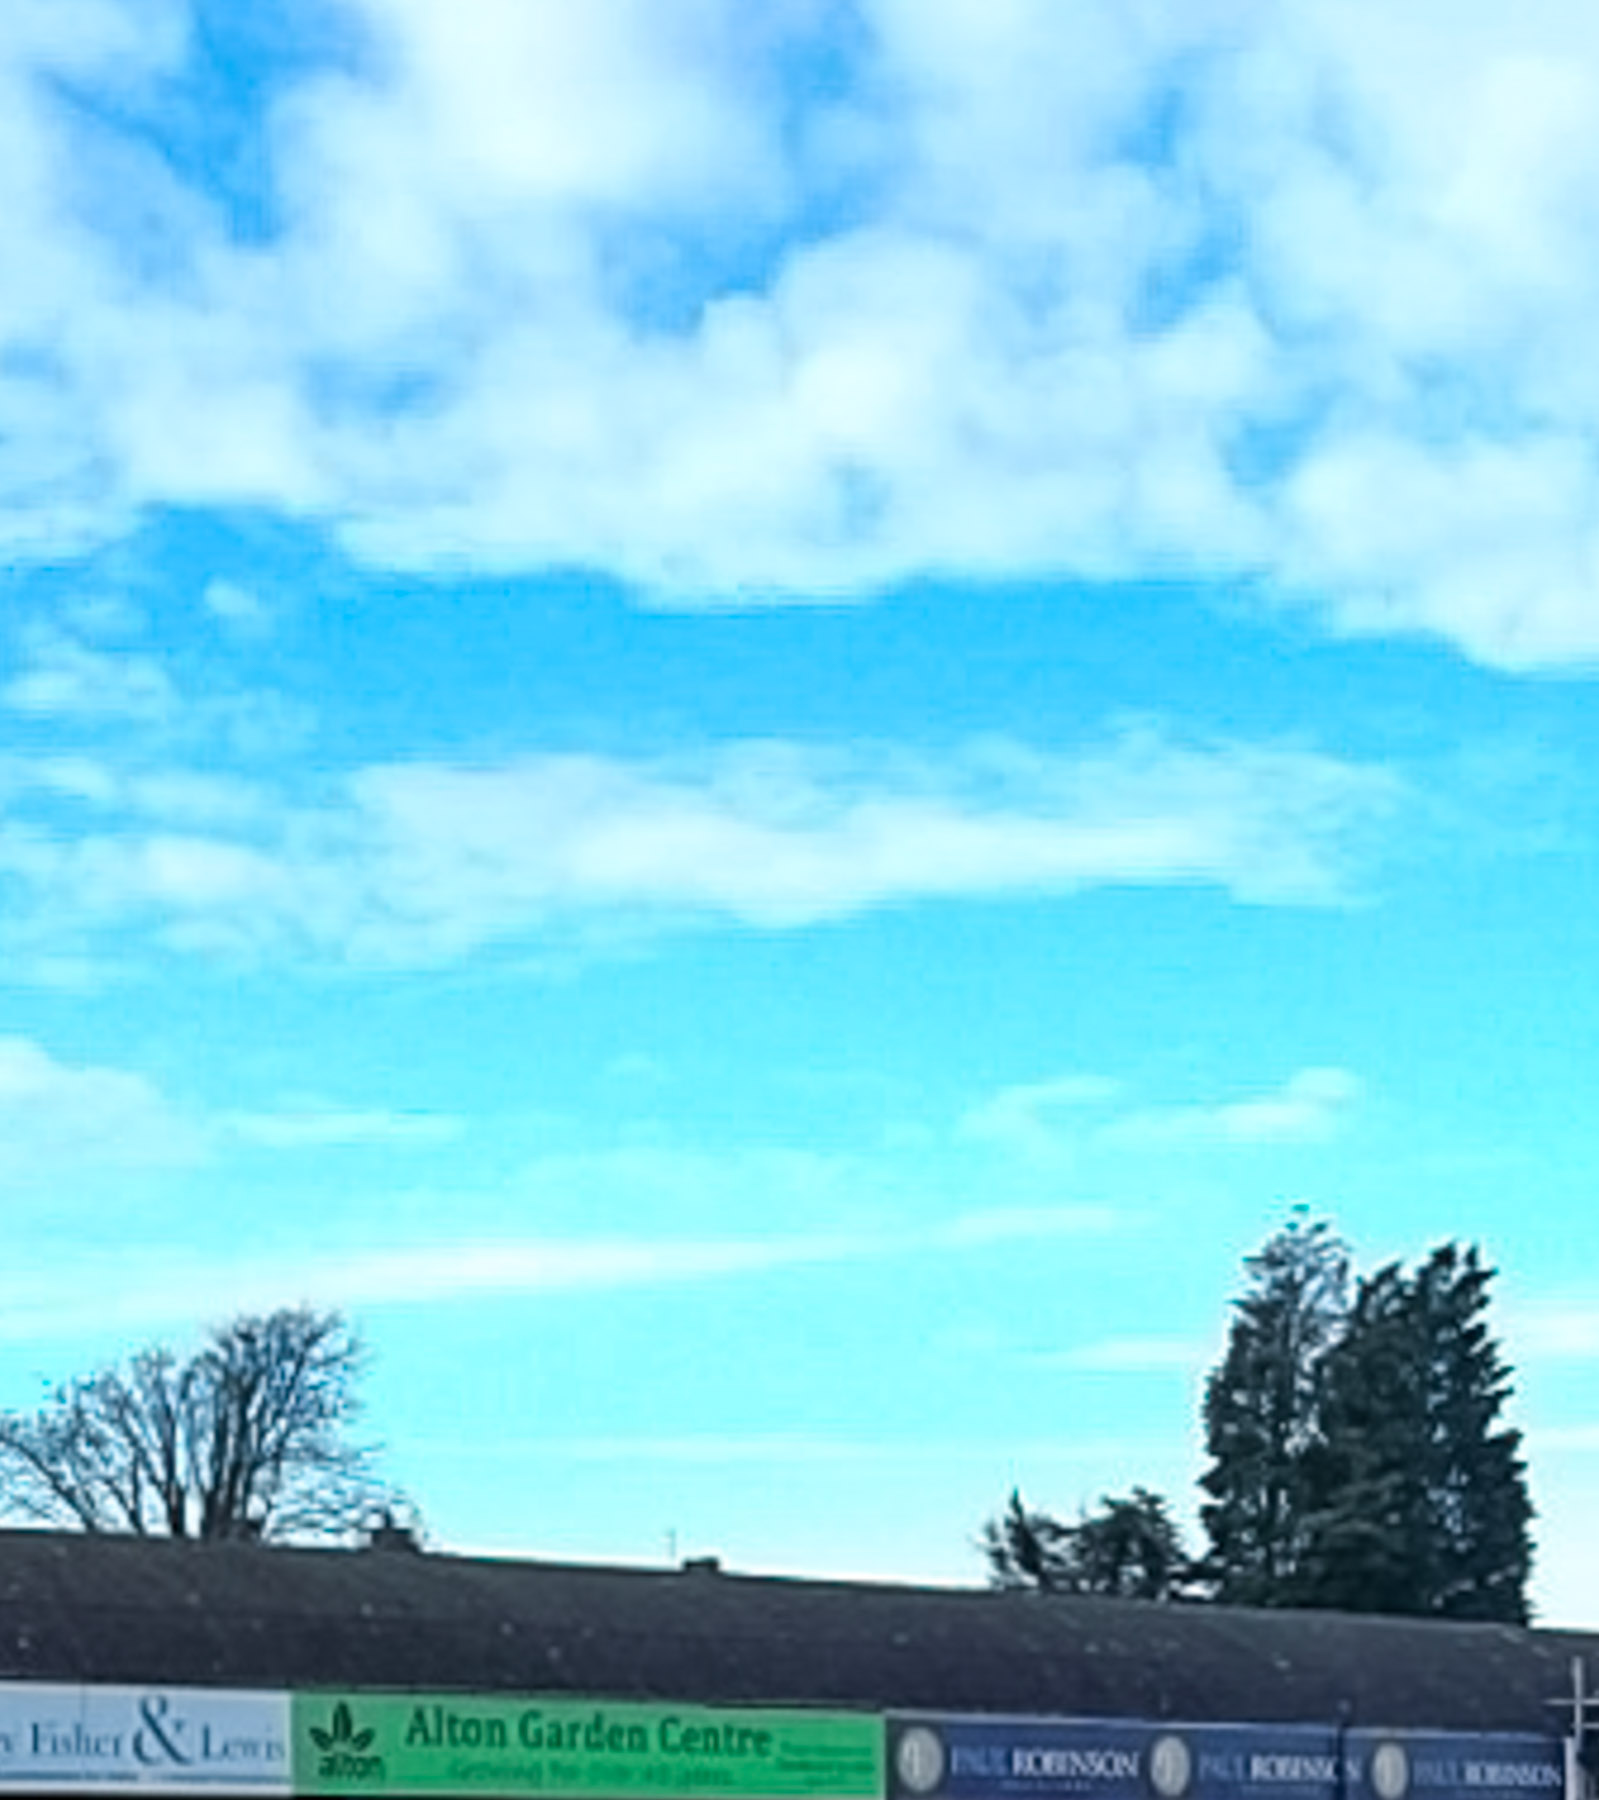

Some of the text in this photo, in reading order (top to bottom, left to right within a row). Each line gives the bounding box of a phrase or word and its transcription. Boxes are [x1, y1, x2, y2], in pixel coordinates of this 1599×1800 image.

[31, 1722, 124, 1758] Fisher
[133, 1694, 191, 1766] &
[202, 1724, 286, 1760] Lewis
[405, 1705, 774, 1758] Alton Garden Centre
[1011, 1747, 1141, 1778] ROBINSON
